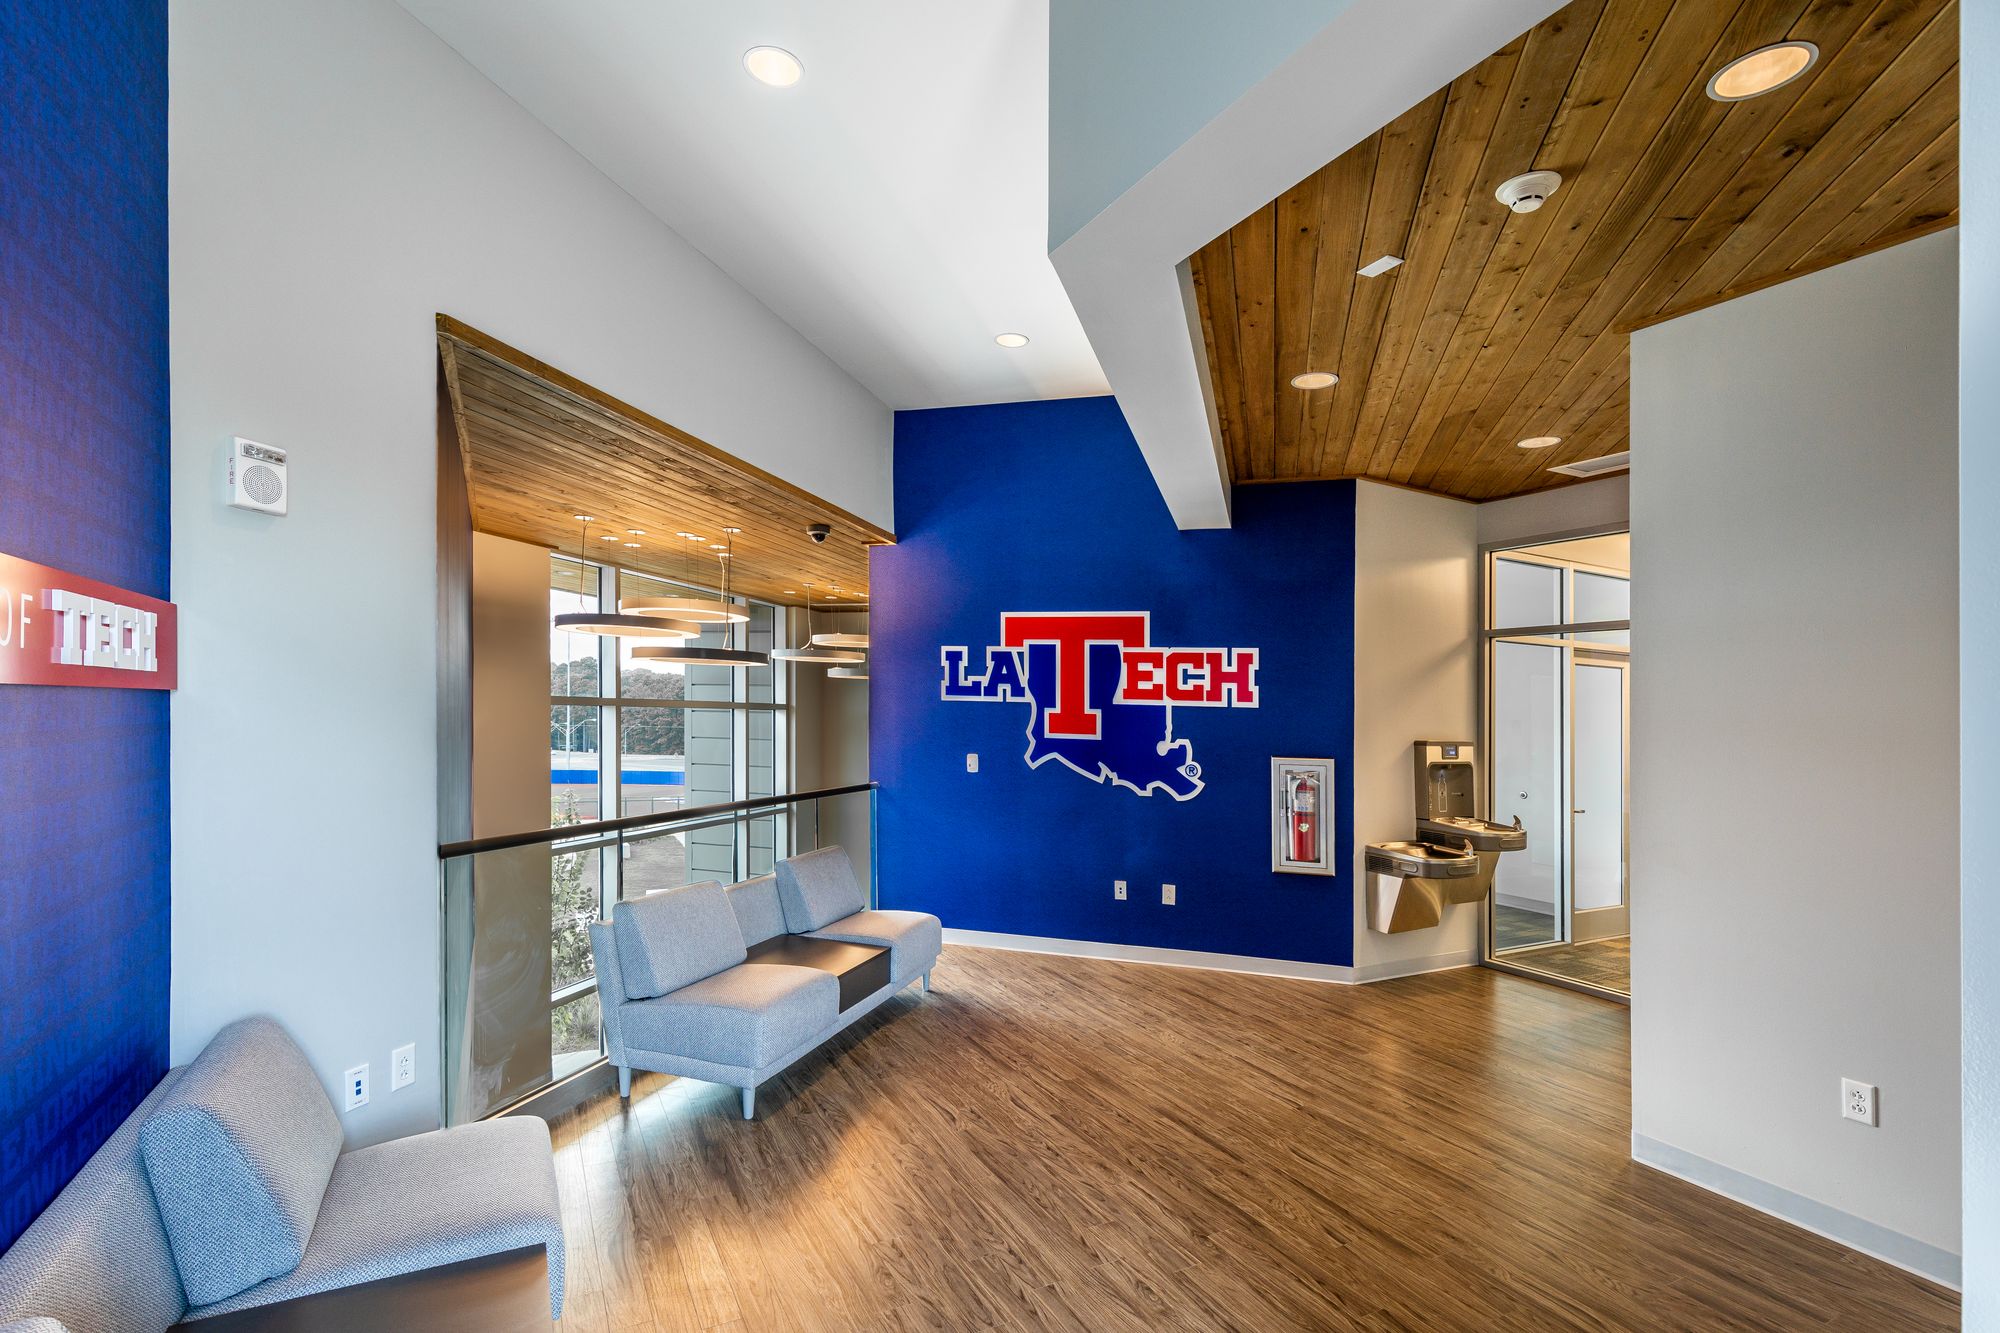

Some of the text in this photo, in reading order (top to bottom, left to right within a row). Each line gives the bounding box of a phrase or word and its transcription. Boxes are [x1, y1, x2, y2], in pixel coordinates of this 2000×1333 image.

[52, 588, 158, 672] TECH
[941, 611, 1259, 740] LA TECH
